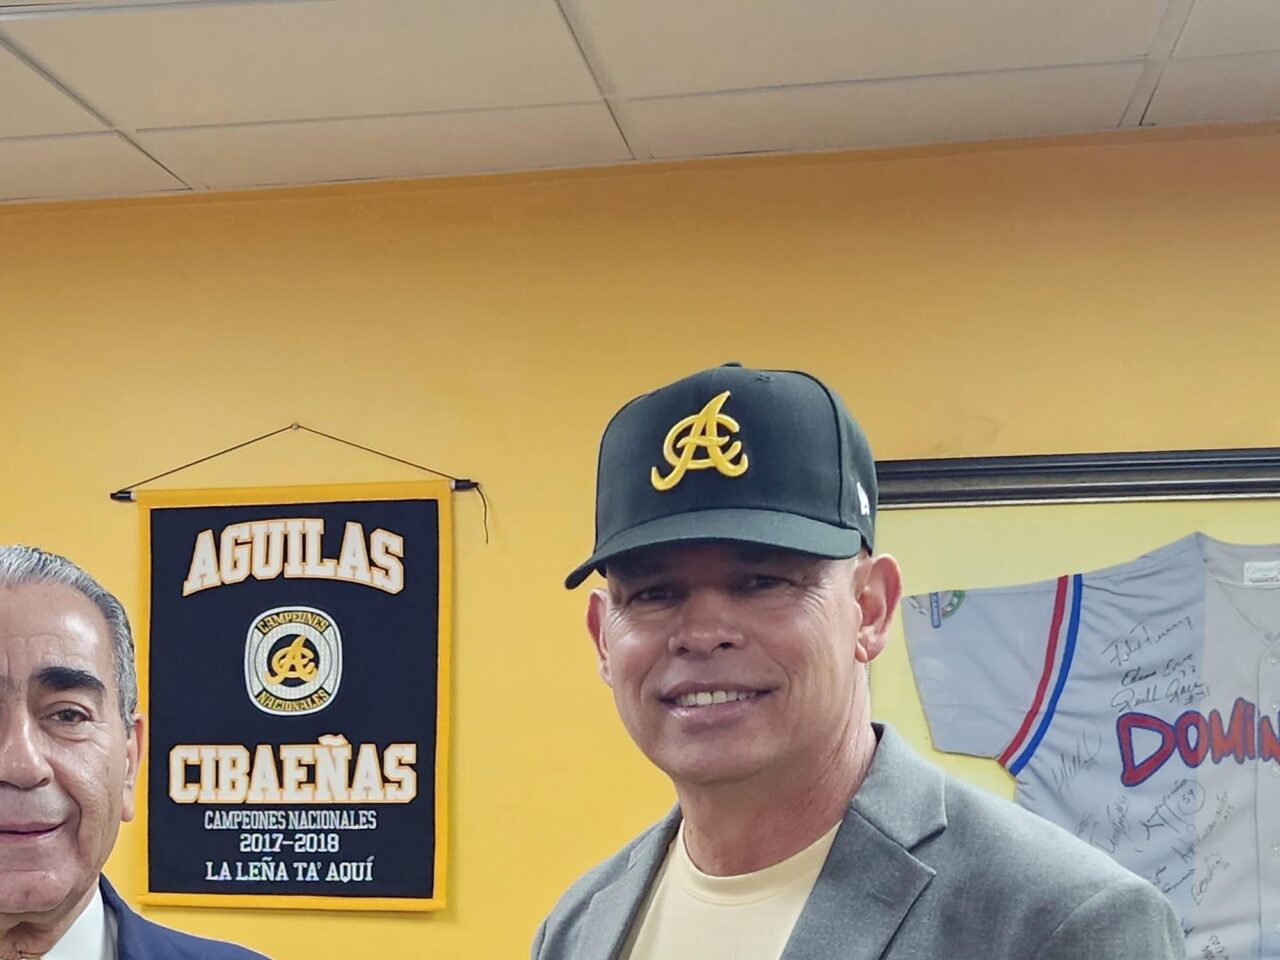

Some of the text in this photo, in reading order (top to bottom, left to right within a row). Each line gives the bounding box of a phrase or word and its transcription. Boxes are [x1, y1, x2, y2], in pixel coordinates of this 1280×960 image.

[182, 517, 404, 597] AGUILAS
[169, 734, 417, 804] CIBAEÑAS
[204, 810, 377, 830] CAMPEONES NACIONALES
[239, 833, 340, 853] 2017-2018
[205, 861, 232, 881] LA
[235, 856, 289, 881] LEÑA
[325, 855, 375, 883] AQUÍ
